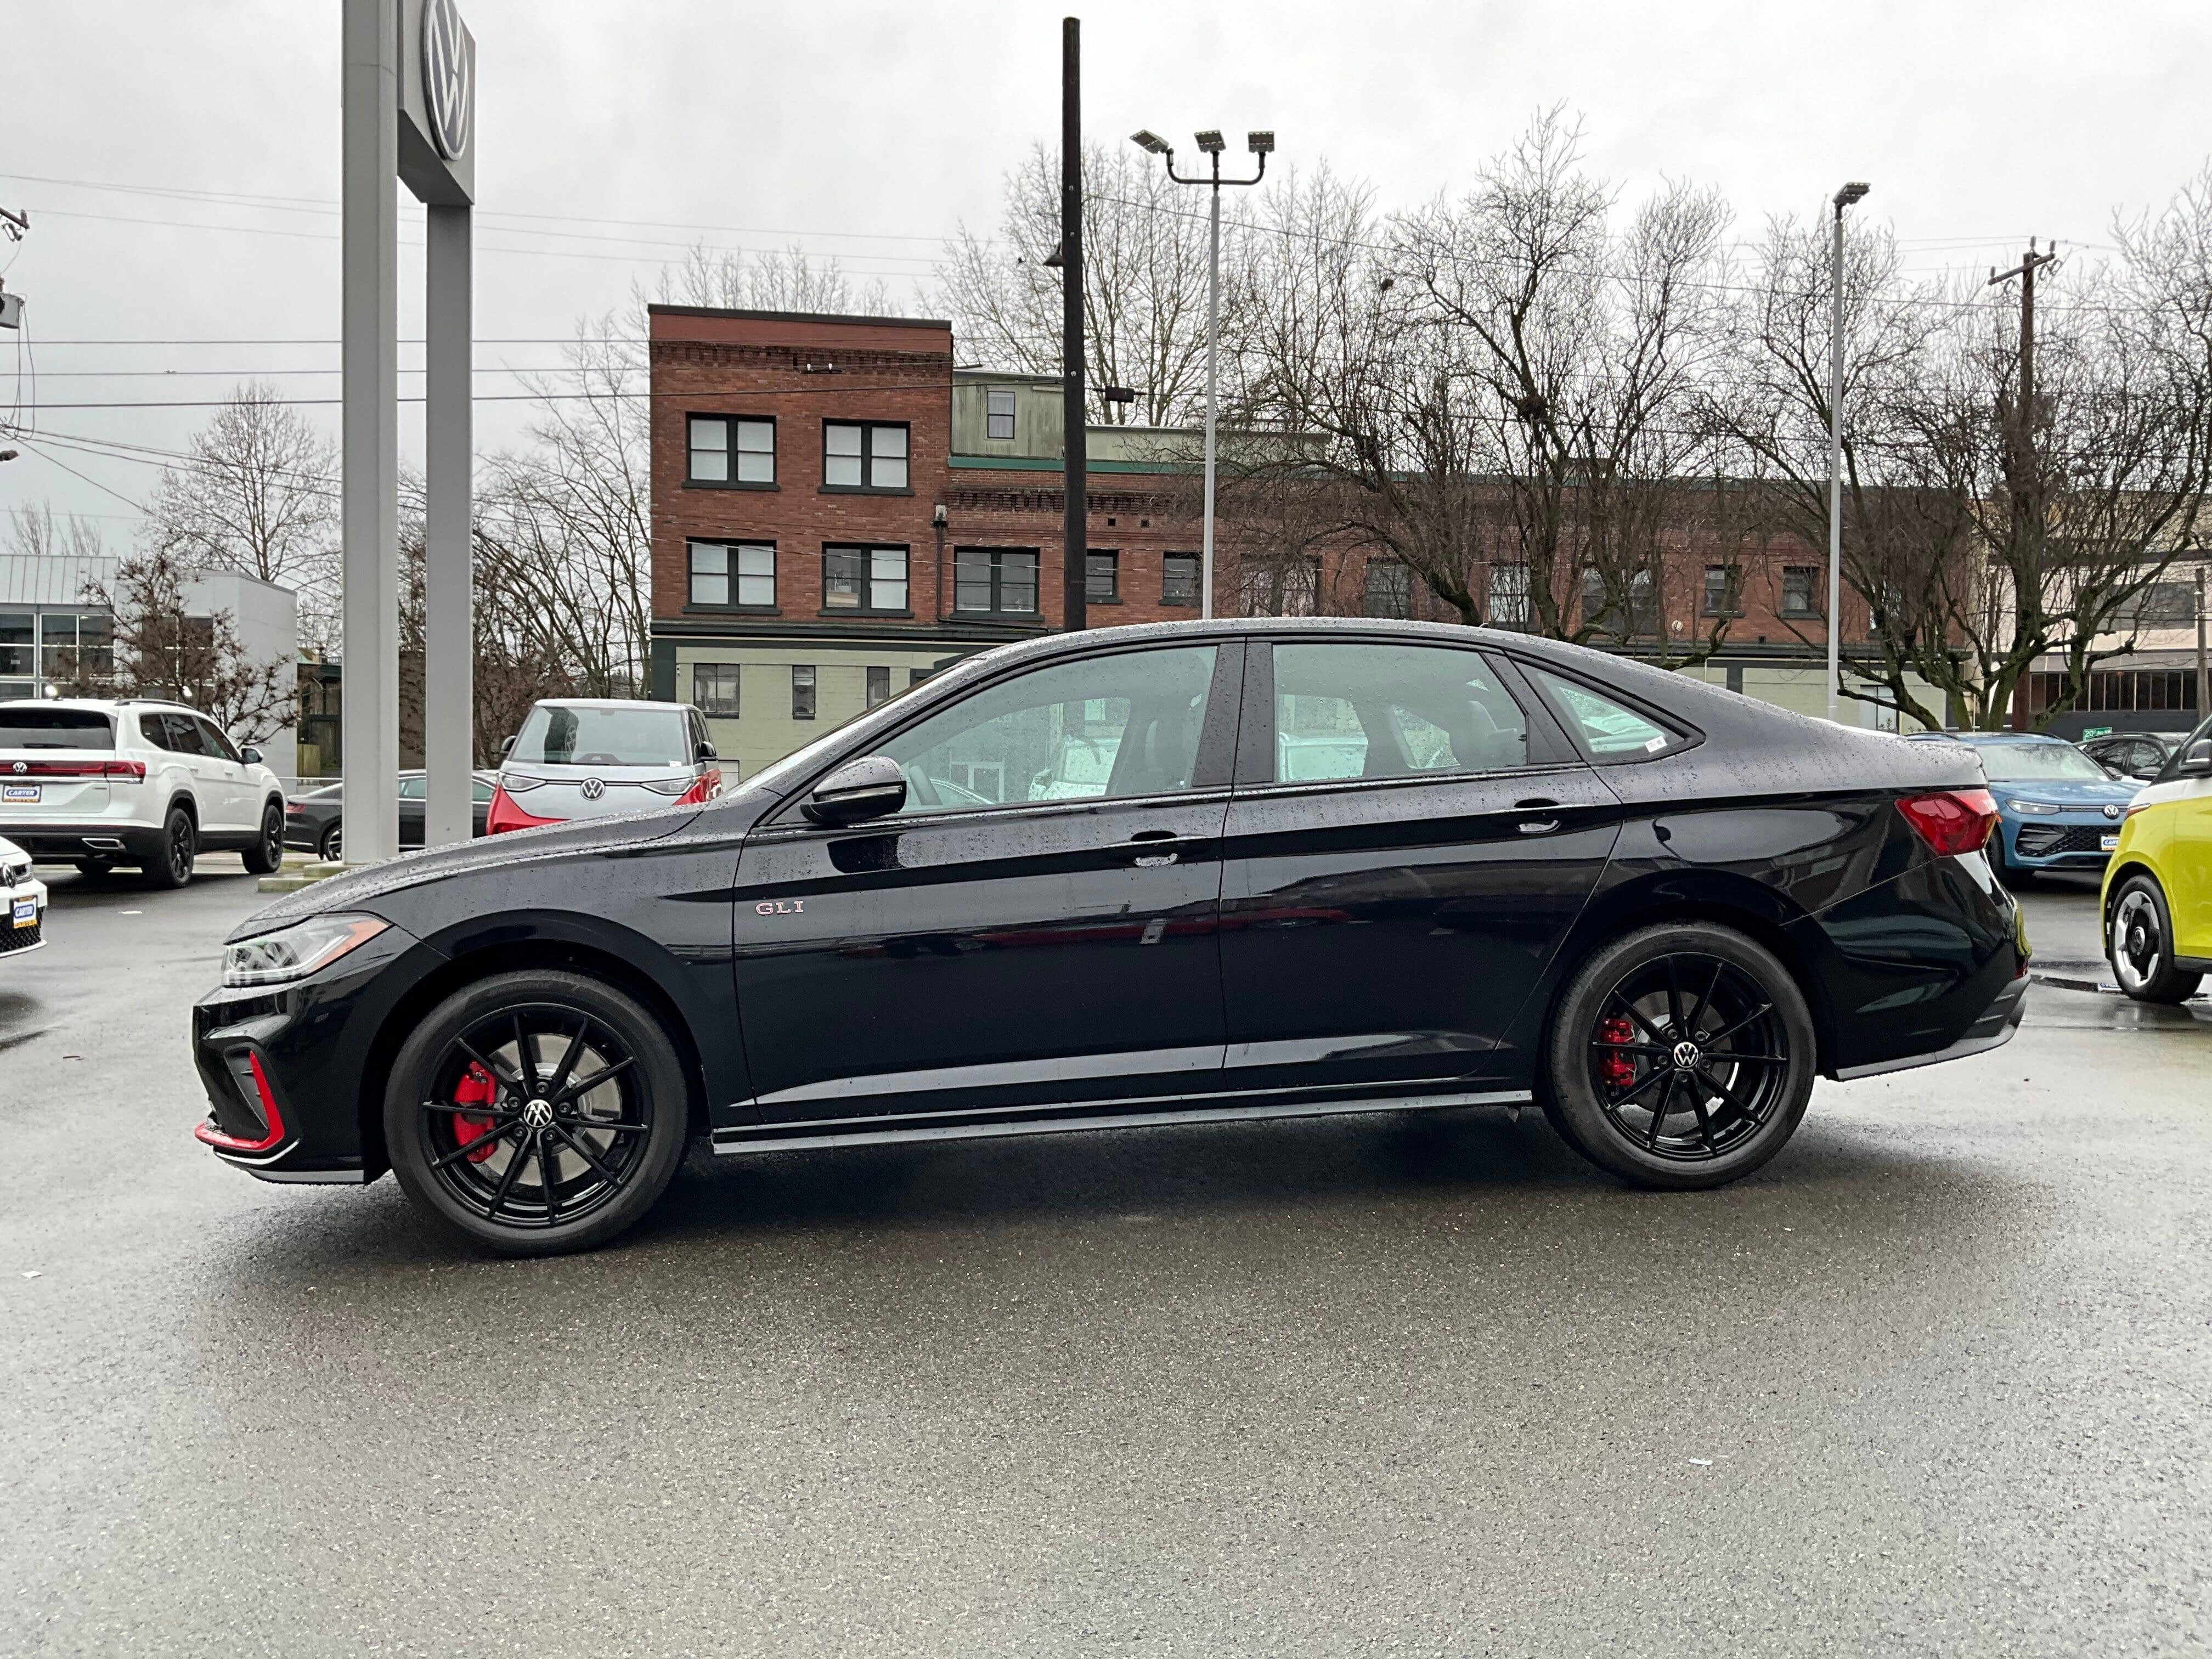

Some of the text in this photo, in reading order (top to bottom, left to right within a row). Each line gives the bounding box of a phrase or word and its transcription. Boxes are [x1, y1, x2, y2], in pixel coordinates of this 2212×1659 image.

[580, 778, 605, 800] VW
[15, 906, 33, 916] CARTER
[755, 901, 804, 916] GLI
